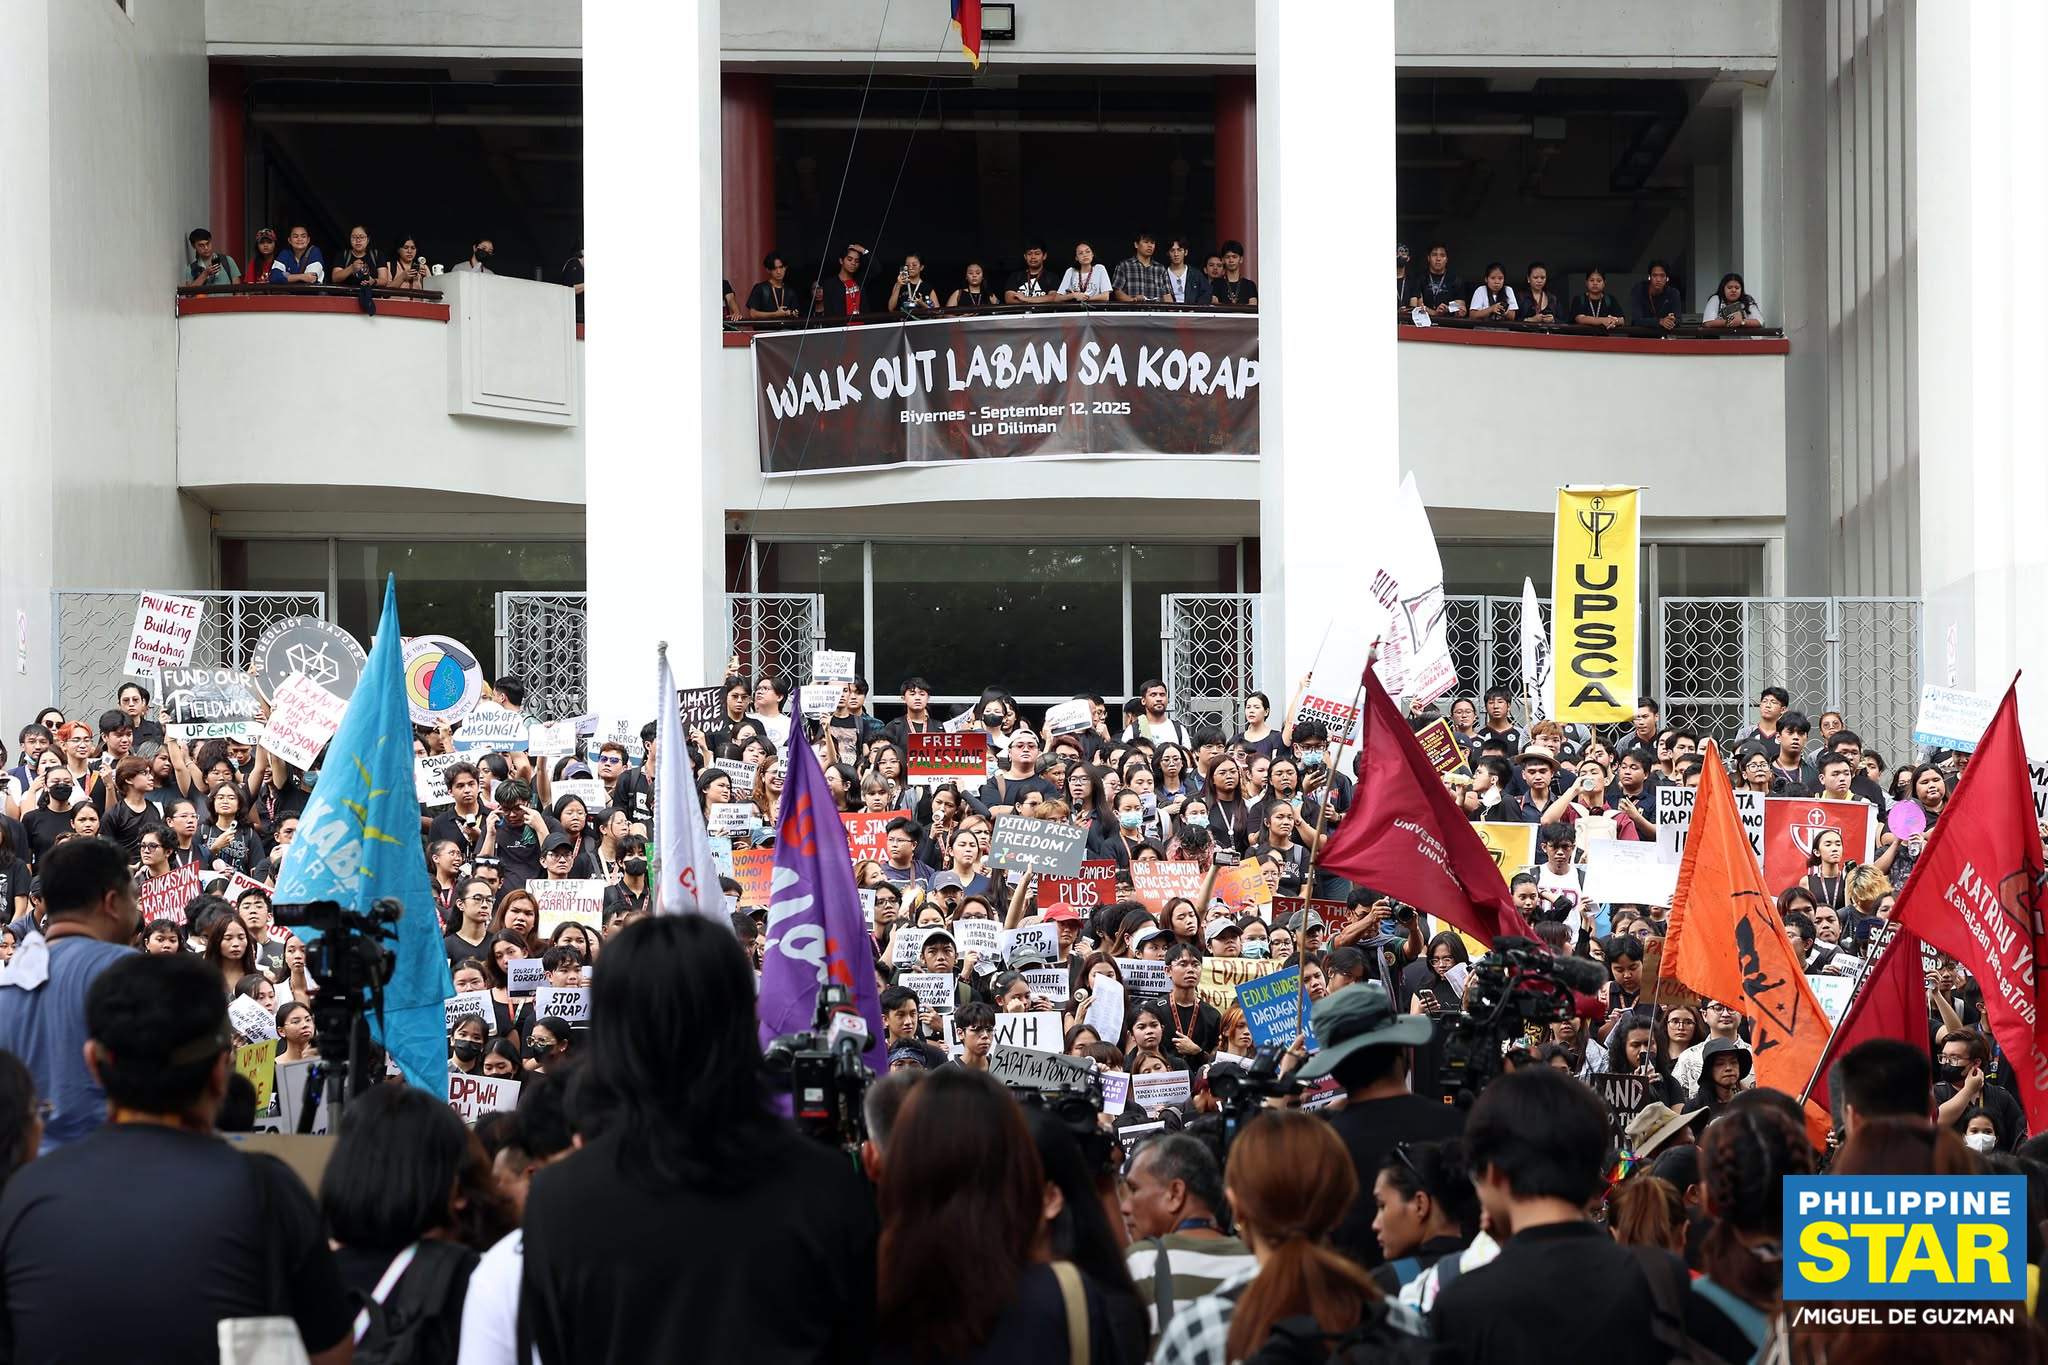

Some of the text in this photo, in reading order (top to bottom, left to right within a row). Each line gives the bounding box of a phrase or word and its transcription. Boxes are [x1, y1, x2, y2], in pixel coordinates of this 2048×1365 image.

[765, 340, 1260, 421] WALK OUT LABAN SA KORAP
[899, 407, 967, 425] Biyernes
[981, 403, 1065, 422] September
[1069, 402, 1090, 419] 12,
[1092, 401, 1132, 417] 2025
[971, 420, 1057, 437] UP Diliman
[140, 595, 198, 620] PNU NCTE
[143, 615, 192, 645] Building
[258, 619, 303, 654] GEOLOGY
[1568, 563, 1622, 708] UPSCA
[134, 634, 186, 660] Pondohan
[131, 650, 155, 668] nang
[164, 669, 253, 688] FUND OUR
[677, 688, 722, 708] LIMATE
[447, 700, 473, 722] SOCIETY
[679, 704, 722, 723] STICE
[1300, 707, 1340, 723] ASSETS OF
[1302, 694, 1361, 721] FREEZE
[467, 708, 518, 725] HANDS OFF
[617, 720, 629, 729] NO
[186, 723, 247, 738] UP GeMS
[461, 721, 520, 738] MASUNGI!
[607, 733, 639, 744] ENERGY
[922, 734, 963, 748] FREE
[1919, 733, 1957, 750] BUKLOD
[422, 755, 456, 769] PONDO
[908, 748, 985, 769] PALESTINE
[864, 819, 888, 834] STAN
[998, 816, 1083, 841] DEFEND PRESS
[853, 834, 877, 846] WITH
[994, 830, 1074, 854] FREEDOM!
[1016, 852, 1059, 868] CMC SC
[734, 867, 763, 877] HINDI
[1077, 864, 1116, 882] CAMPUS
[1132, 862, 1201, 876] ORG TAMBAYAN
[141, 864, 199, 899] EDUKASYON,
[1135, 876, 1202, 890] SPACES CMC
[142, 884, 199, 915] KARAPATAN
[1059, 881, 1099, 907] PUBS
[1015, 930, 1043, 945] STOP
[1944, 882, 1991, 952] Kabataan
[1999, 976, 2013, 998] sa
[2008, 986, 2037, 1026] Trib
[1119, 963, 1135, 971] TAMA
[1130, 971, 1166, 980] ITIGIL ANG
[908, 981, 944, 989] BAHAIN NG
[1027, 974, 1060, 984] DUTERTE
[1128, 979, 1166, 988] KALBARYO!
[551, 992, 581, 1005] STOP
[935, 989, 950, 997] ANG
[1241, 983, 1272, 1009] EDUK
[446, 1001, 483, 1014] MARCOS,
[544, 1003, 588, 1017] KORAP!
[243, 1044, 269, 1068] UP NOT
[991, 1048, 1034, 1078] SAPAT
[1027, 1060, 1043, 1079] NA
[1038, 1055, 1084, 1084] PONDO
[449, 1076, 498, 1106] DPWH
[1114, 1080, 1125, 1088] AT
